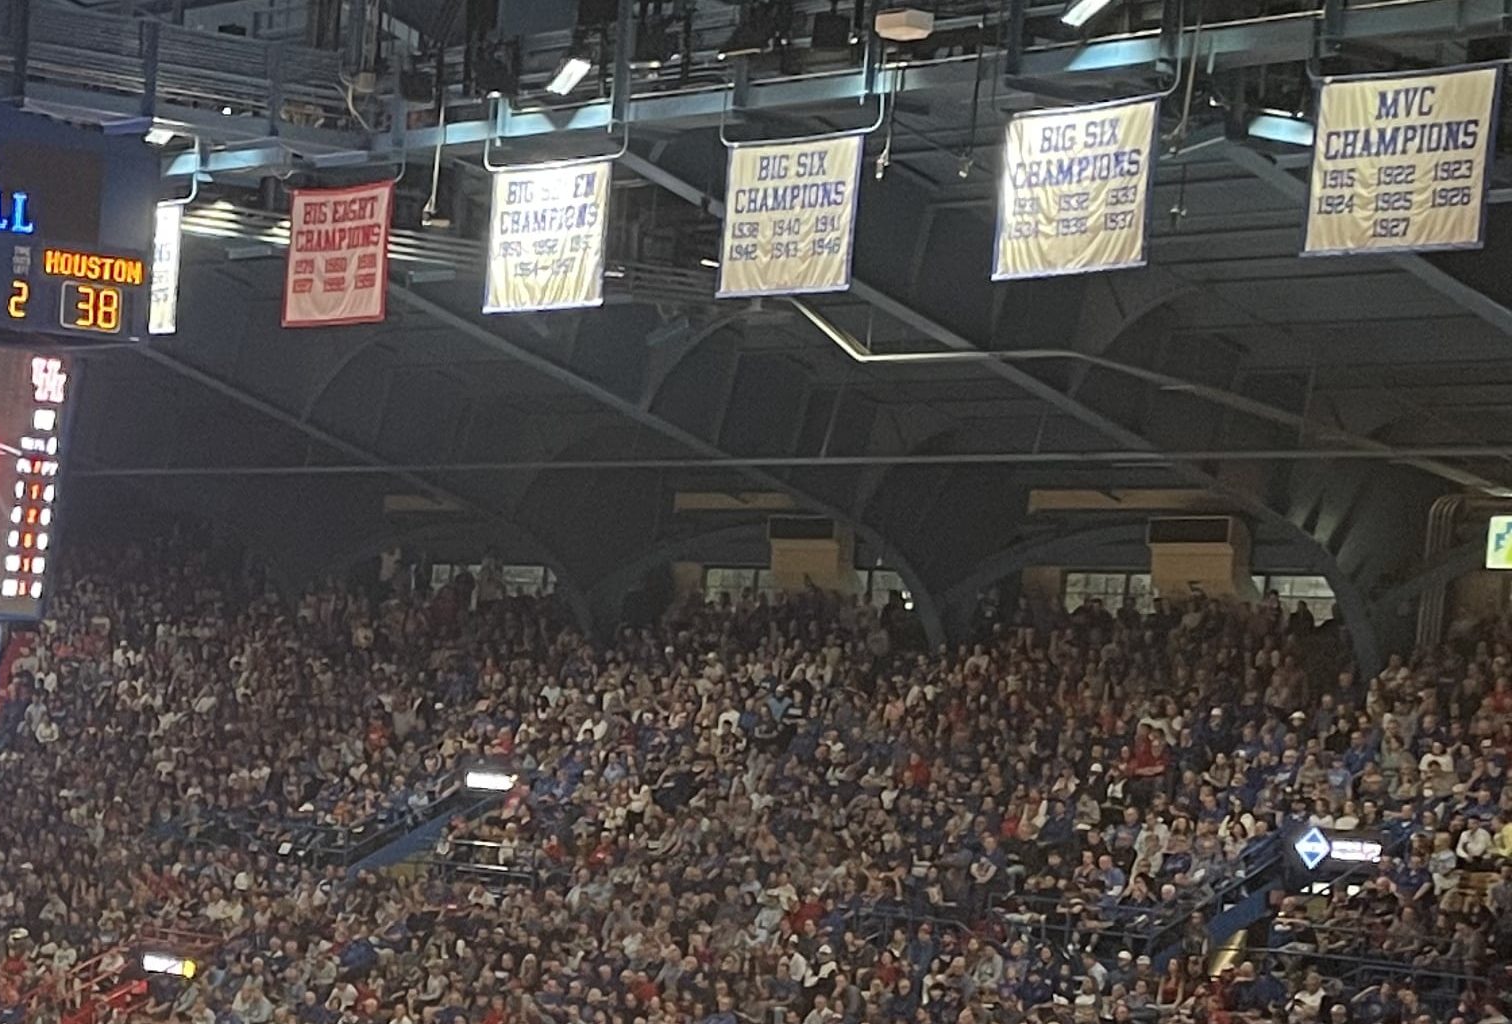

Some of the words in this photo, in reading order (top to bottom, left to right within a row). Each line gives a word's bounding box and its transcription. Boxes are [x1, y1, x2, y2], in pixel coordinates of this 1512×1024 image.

[1375, 86, 1436, 120] MVC
[1040, 124, 1077, 154] BIG
[1084, 118, 1121, 148] SIX
[1324, 119, 1480, 161] CHAMPIONS
[757, 154, 790, 182] BIG
[796, 151, 829, 178] SIX
[1012, 148, 1142, 190] CHAMPIONS
[1376, 164, 1416, 187] 1922
[506, 181, 535, 205] BIG
[734, 181, 846, 214] CHAMPIONS
[303, 202, 327, 225] BIG
[500, 202, 600, 235] CHAMPIONS
[1371, 217, 1411, 239] 1927
[295, 222, 382, 252] CHAMPIONS
[44, 249, 144, 286] HOUSTON
[7, 280, 29, 319] 2
[75, 287, 119, 333] 38
